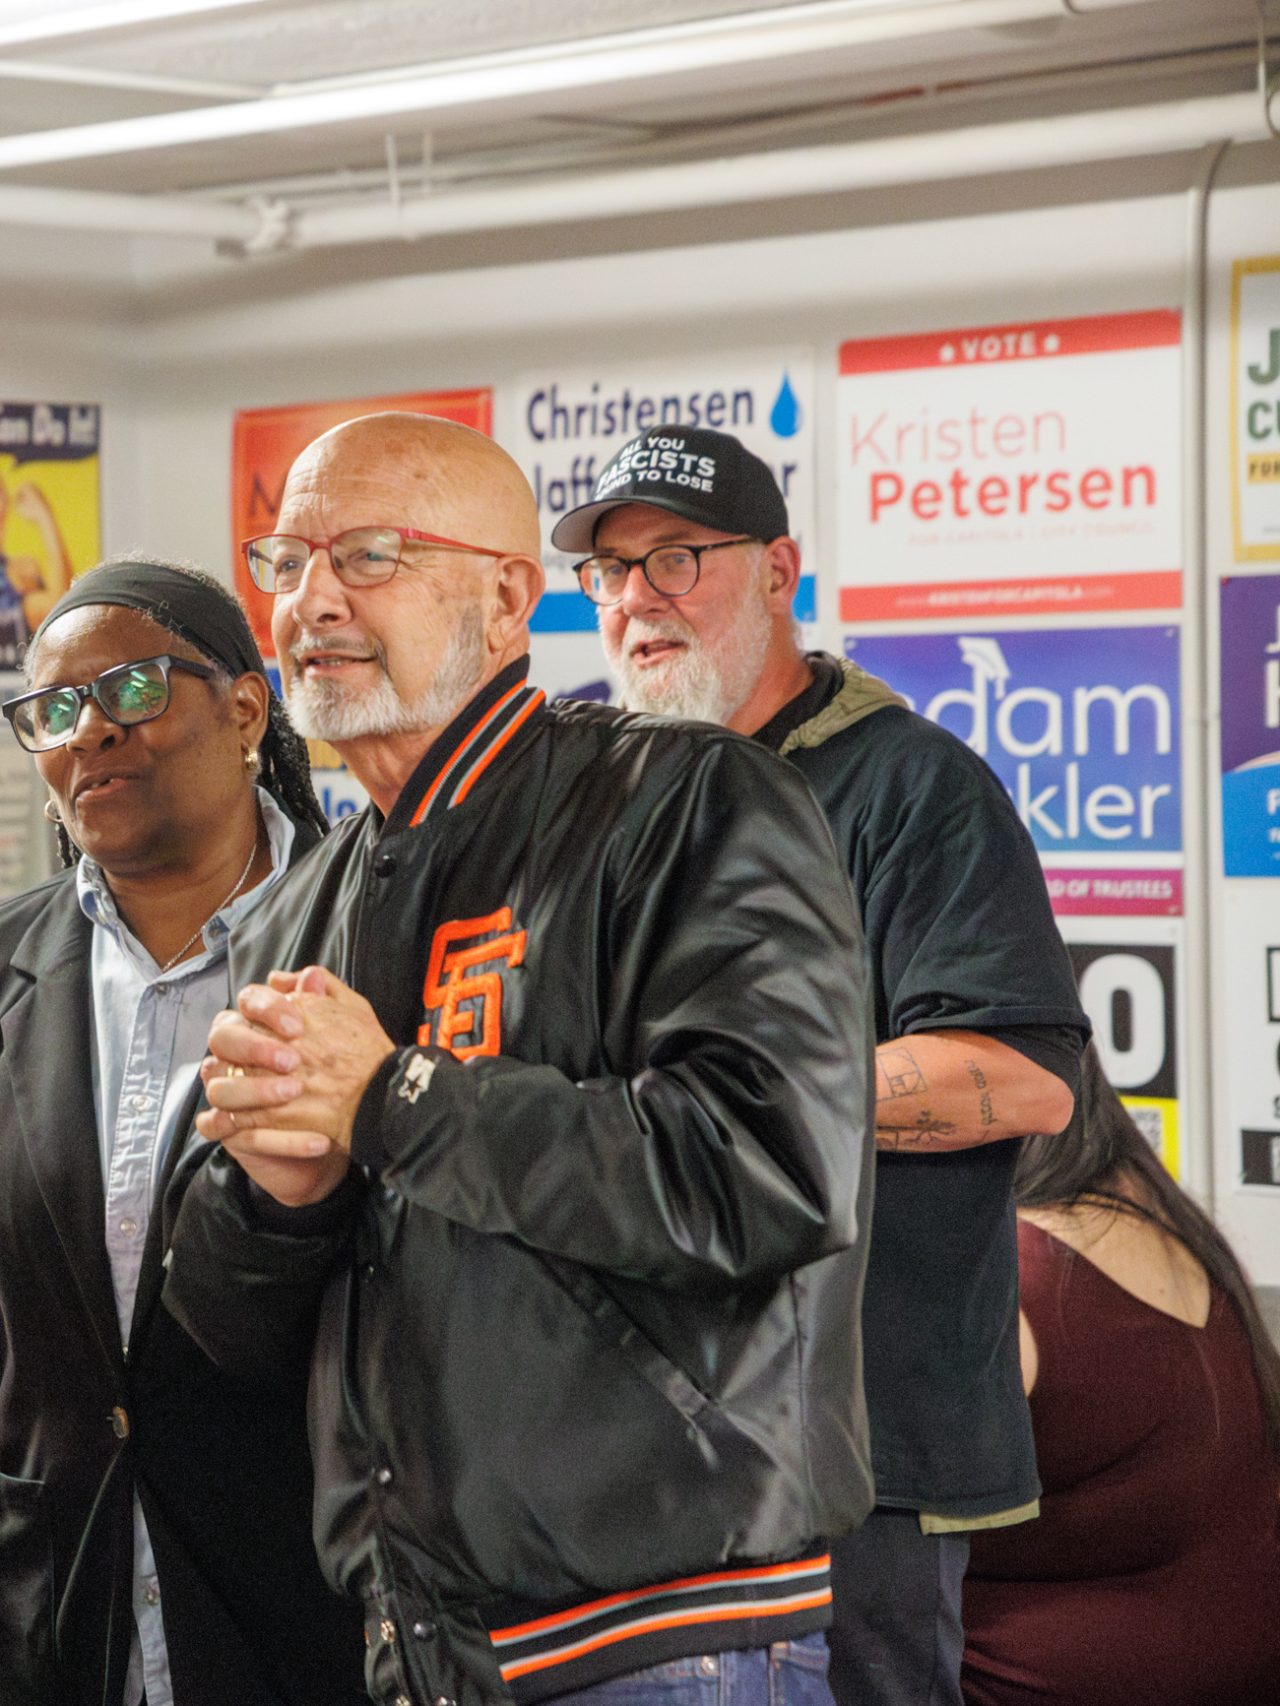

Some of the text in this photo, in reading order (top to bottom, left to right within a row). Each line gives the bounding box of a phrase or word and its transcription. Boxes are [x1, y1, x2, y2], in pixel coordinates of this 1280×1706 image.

[962, 333, 1036, 360] VOTE
[527, 383, 753, 441] Christensen
[850, 405, 1066, 466] Kristen
[647, 436, 685, 451] YOU
[596, 449, 716, 493] FASCISTS
[636, 469, 662, 482] TO
[665, 470, 714, 493] LOSE
[869, 463, 1156, 523] Petersen
[906, 637, 1172, 758] dam
[1017, 763, 1172, 840] kler
[1093, 879, 1172, 900] TRUSTEES
